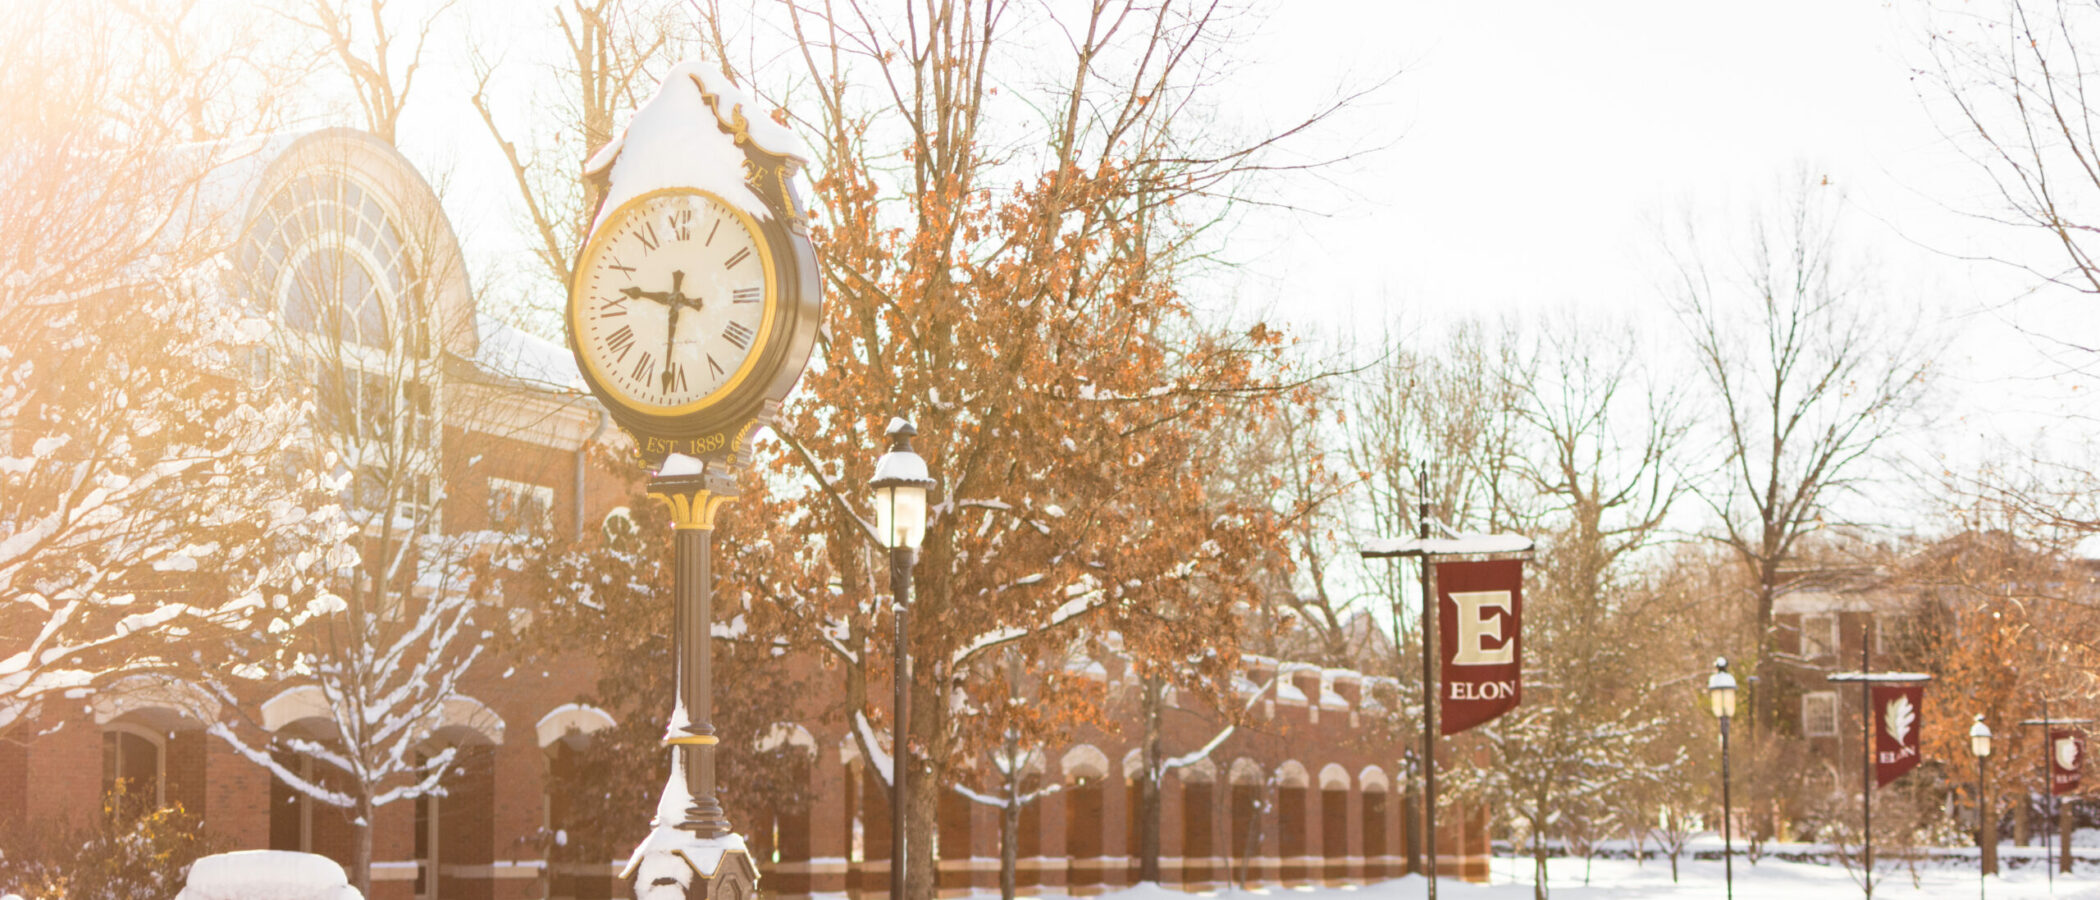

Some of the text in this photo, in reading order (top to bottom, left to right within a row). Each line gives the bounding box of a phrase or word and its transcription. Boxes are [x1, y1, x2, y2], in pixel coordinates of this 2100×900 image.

[633, 221, 660, 257] XI
[608, 256, 637, 281] X
[724, 246, 751, 270] II
[732, 287, 760, 304] III
[706, 352, 725, 382] V
[690, 432, 725, 455] 1889
[1448, 590, 1514, 666] E
[1450, 680, 1516, 700] ELON
